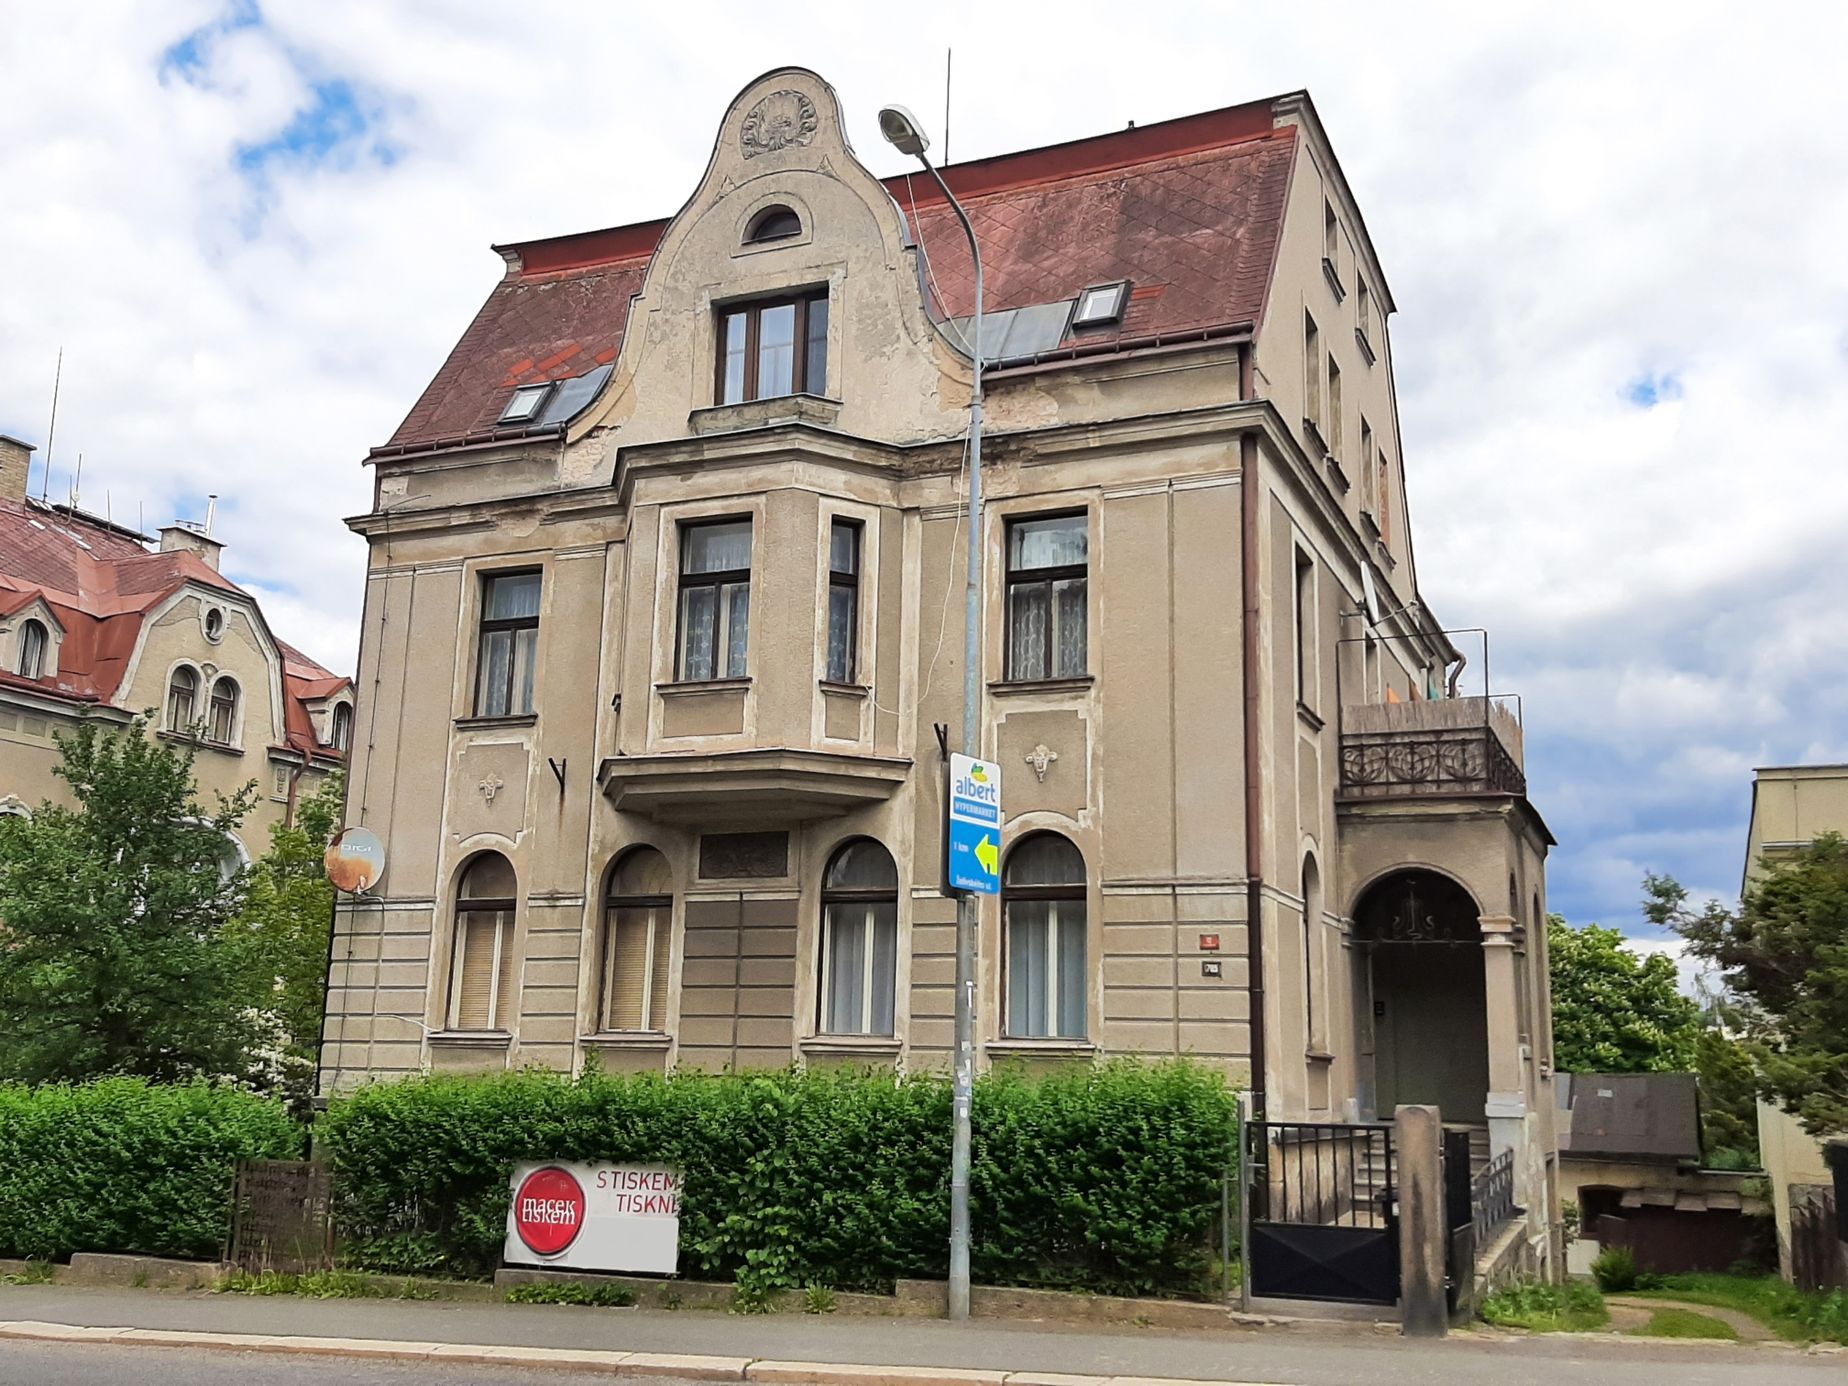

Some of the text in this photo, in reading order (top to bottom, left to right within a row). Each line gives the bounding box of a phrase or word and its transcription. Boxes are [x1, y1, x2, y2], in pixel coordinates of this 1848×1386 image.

[956, 776, 996, 802] albert
[955, 800, 996, 818] HYPERMARKET
[958, 841, 969, 852] km
[596, 1170, 679, 1191] S TISKEM
[523, 1197, 576, 1215] macek
[522, 1208, 576, 1225] tiskem
